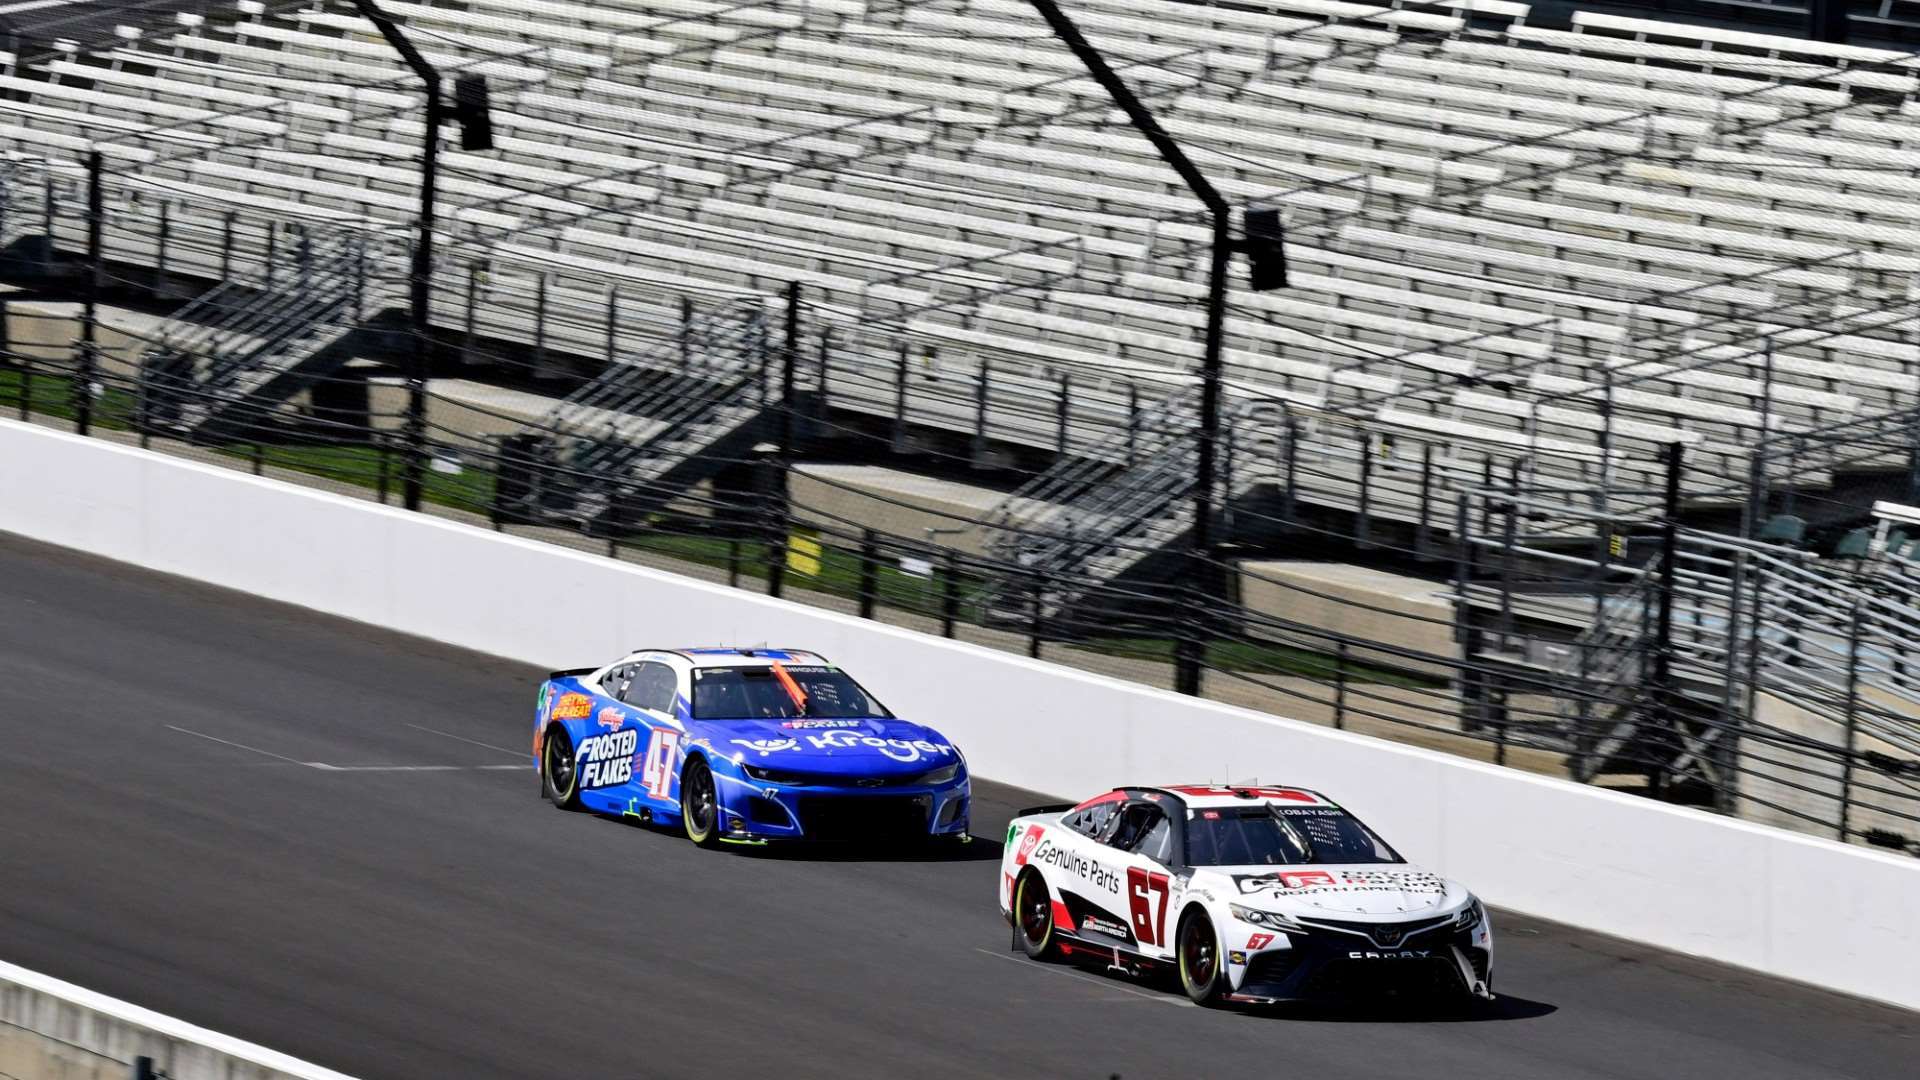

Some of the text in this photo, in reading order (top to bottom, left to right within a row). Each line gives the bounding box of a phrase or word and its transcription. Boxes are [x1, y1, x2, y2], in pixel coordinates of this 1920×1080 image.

[576, 729, 637, 762] FROSTED
[808, 730, 951, 762] Kroger
[580, 756, 632, 788] FLAKES
[643, 727, 678, 800] 47
[762, 787, 778, 800] 47
[1035, 839, 1088, 878] Genuine
[1089, 860, 1120, 894] Parts
[1127, 866, 1169, 948] 67
[1246, 933, 1275, 949] 67
[1349, 950, 1431, 959] CAMRY
